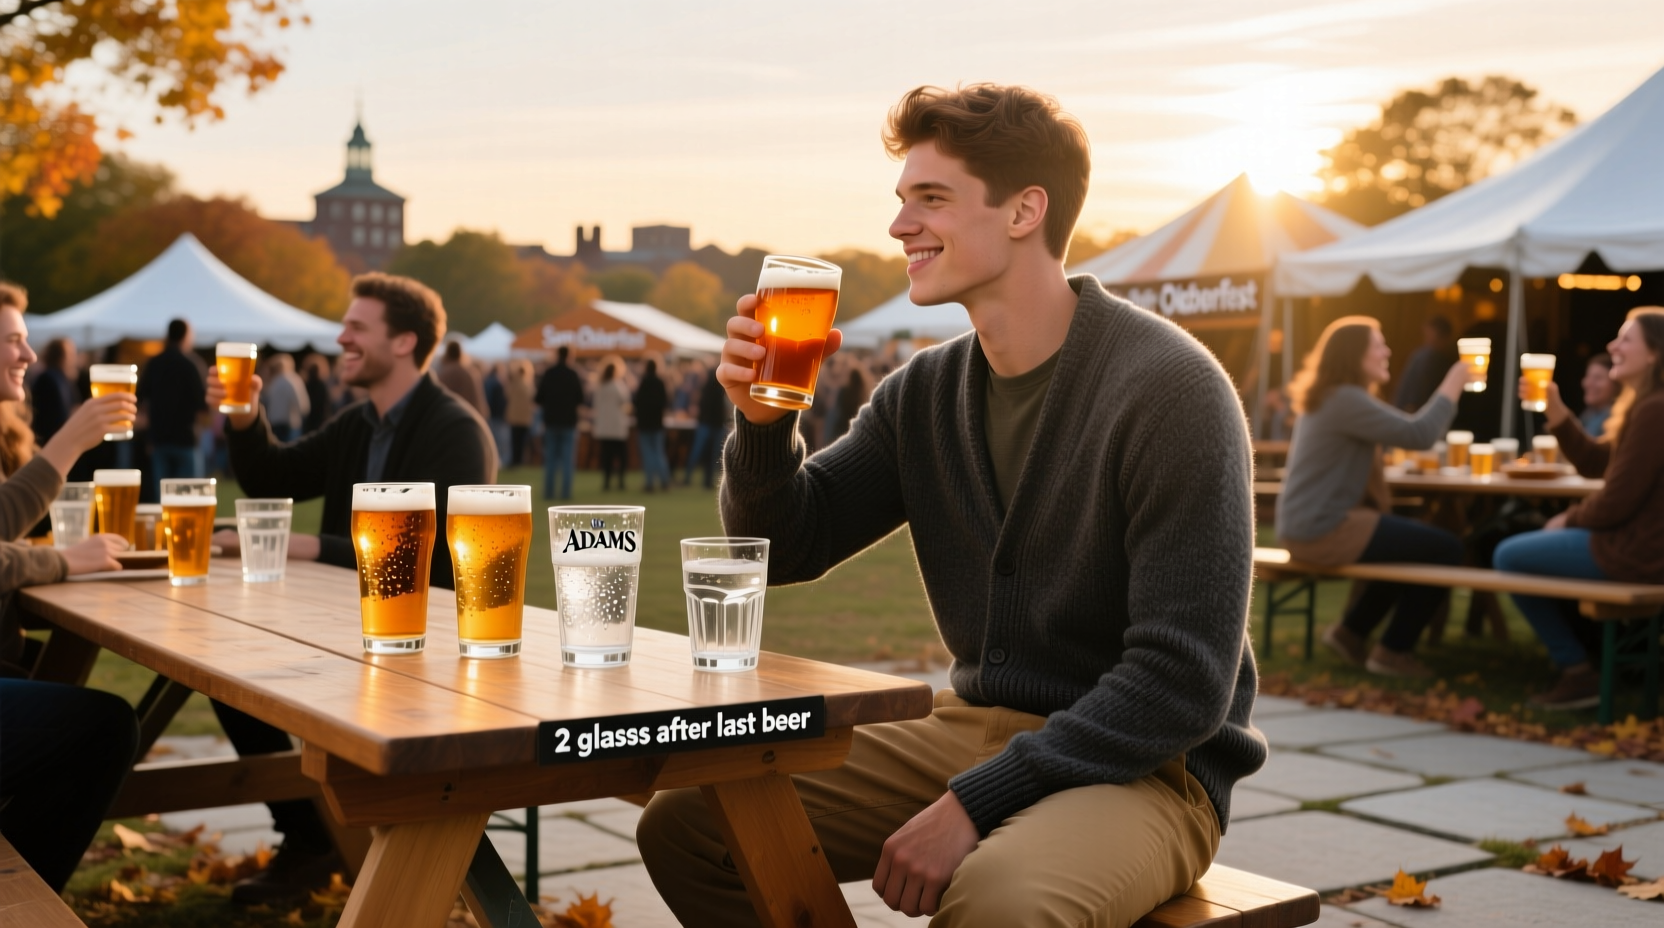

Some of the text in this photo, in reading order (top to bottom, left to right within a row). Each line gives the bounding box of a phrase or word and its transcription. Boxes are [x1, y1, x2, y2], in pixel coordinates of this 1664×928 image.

[562, 528, 637, 554] ADAMS
[554, 707, 811, 758] 2 glasss after last beer
